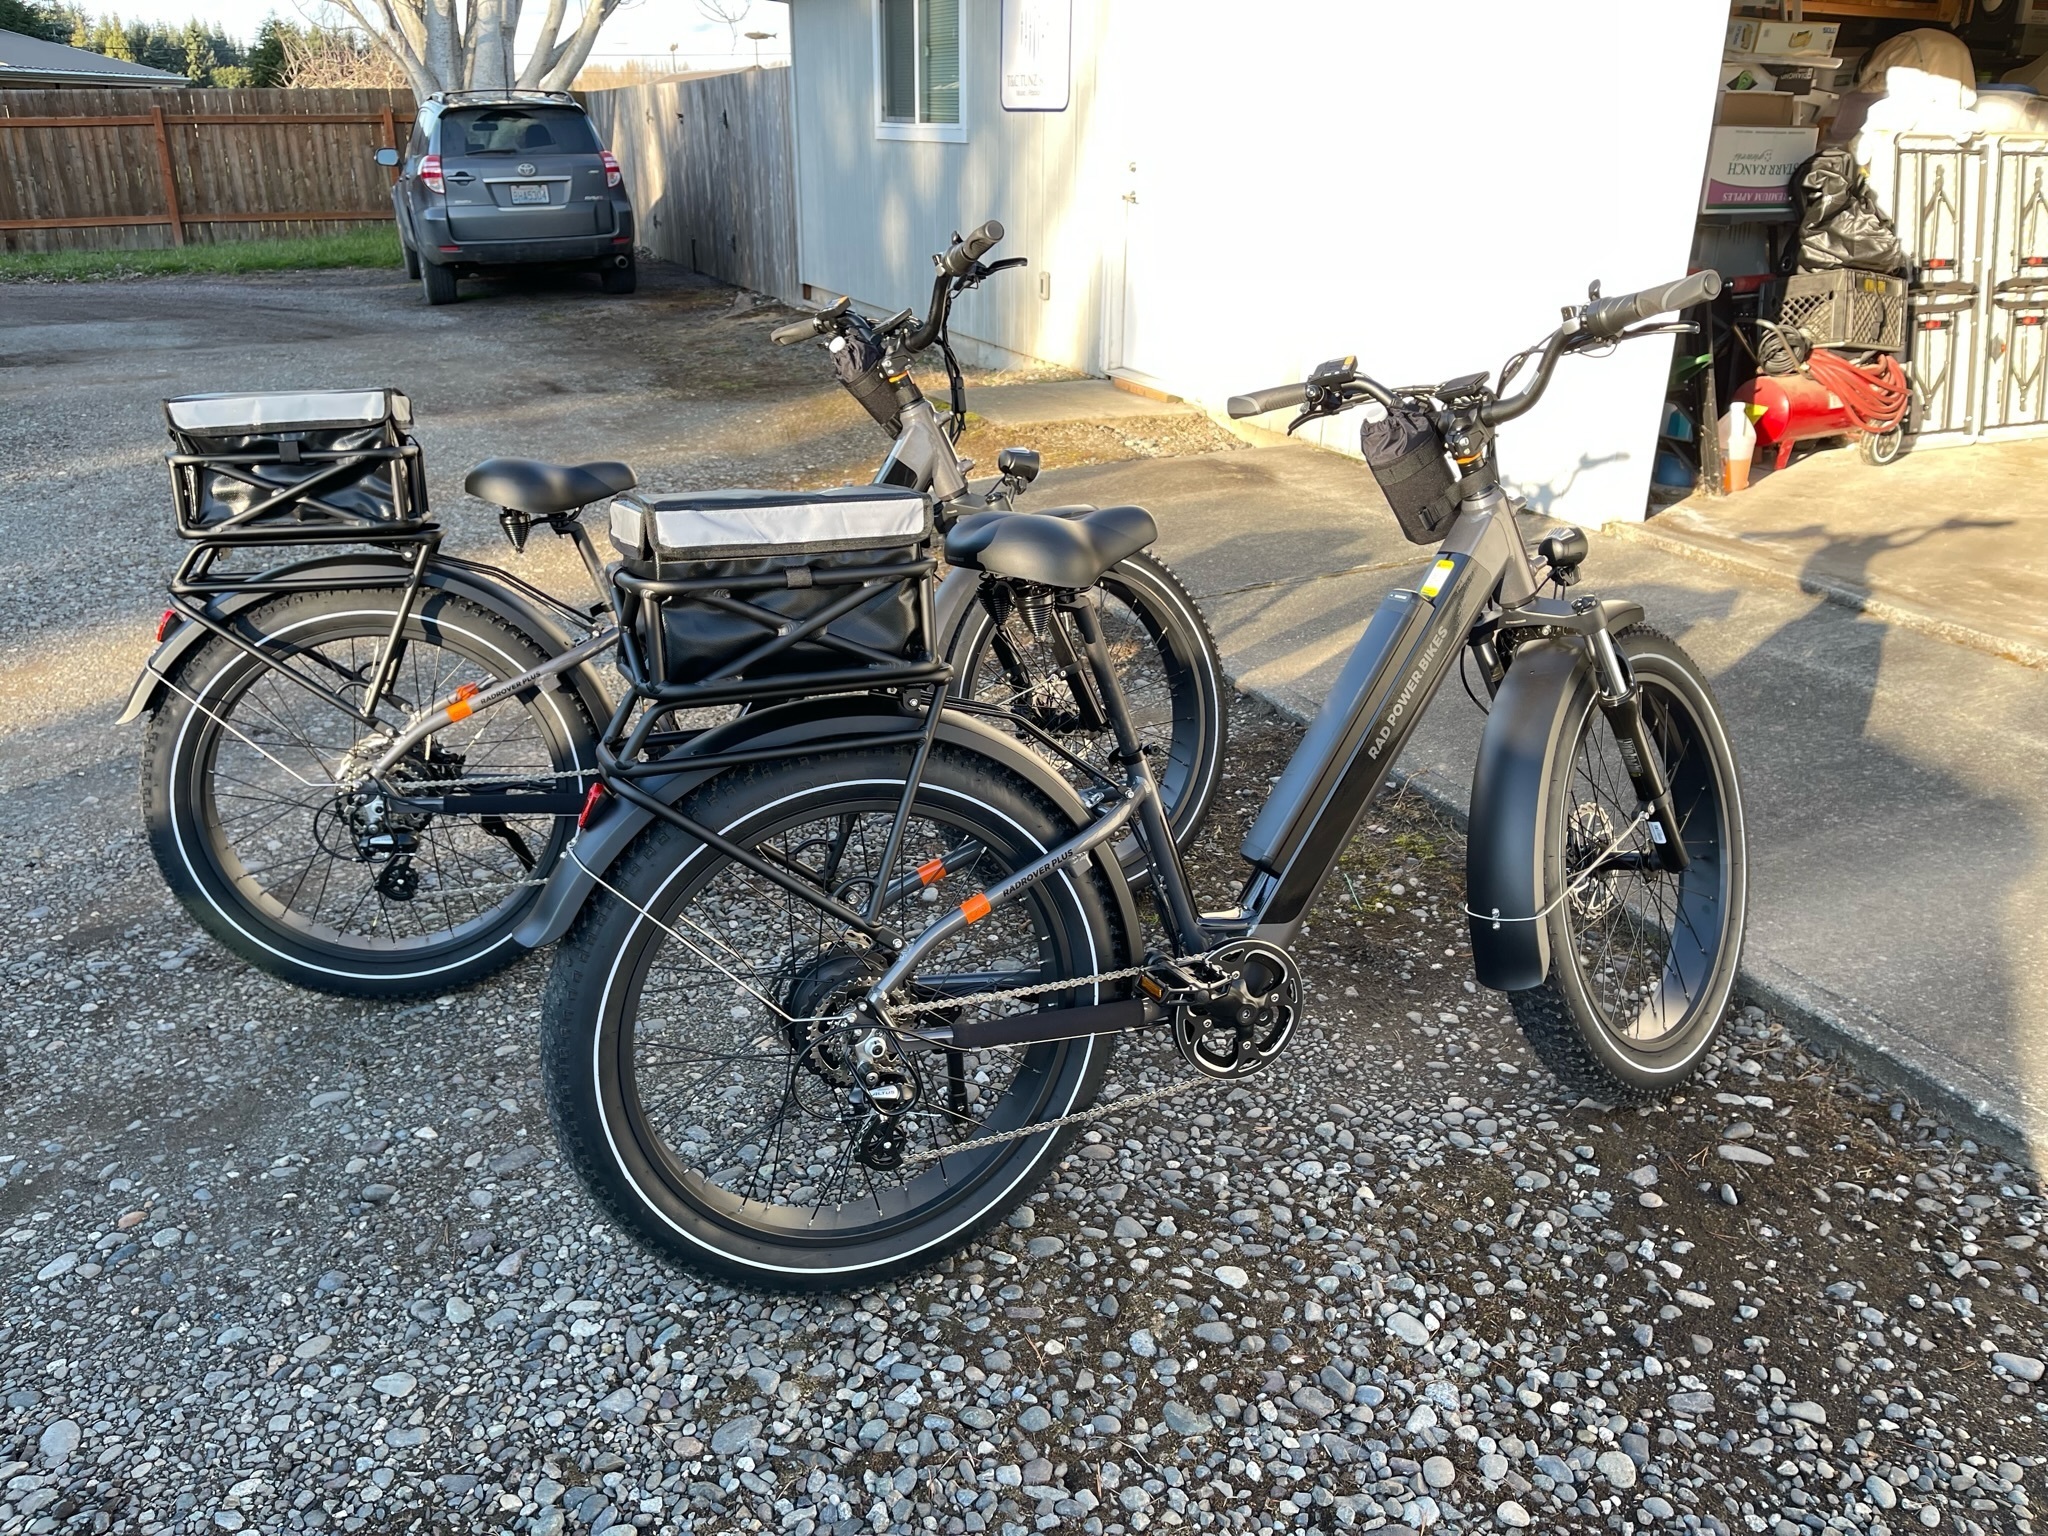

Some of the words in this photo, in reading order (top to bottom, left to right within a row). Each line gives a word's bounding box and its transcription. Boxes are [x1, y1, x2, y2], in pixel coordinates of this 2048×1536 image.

[1727, 162, 1768, 176] RANCH
[1768, 162, 1799, 176] STARR
[1722, 192, 1753, 202] APPLES
[1754, 192, 1788, 202] REMIUM
[480, 682, 521, 704] RADROVER
[522, 670, 541, 685] PLUS
[1367, 724, 1391, 760] RAD
[1388, 670, 1424, 727] POWER
[1418, 625, 1448, 672] BIKES
[1003, 864, 1051, 897] RADROVER
[1051, 849, 1073, 867] PLUS
